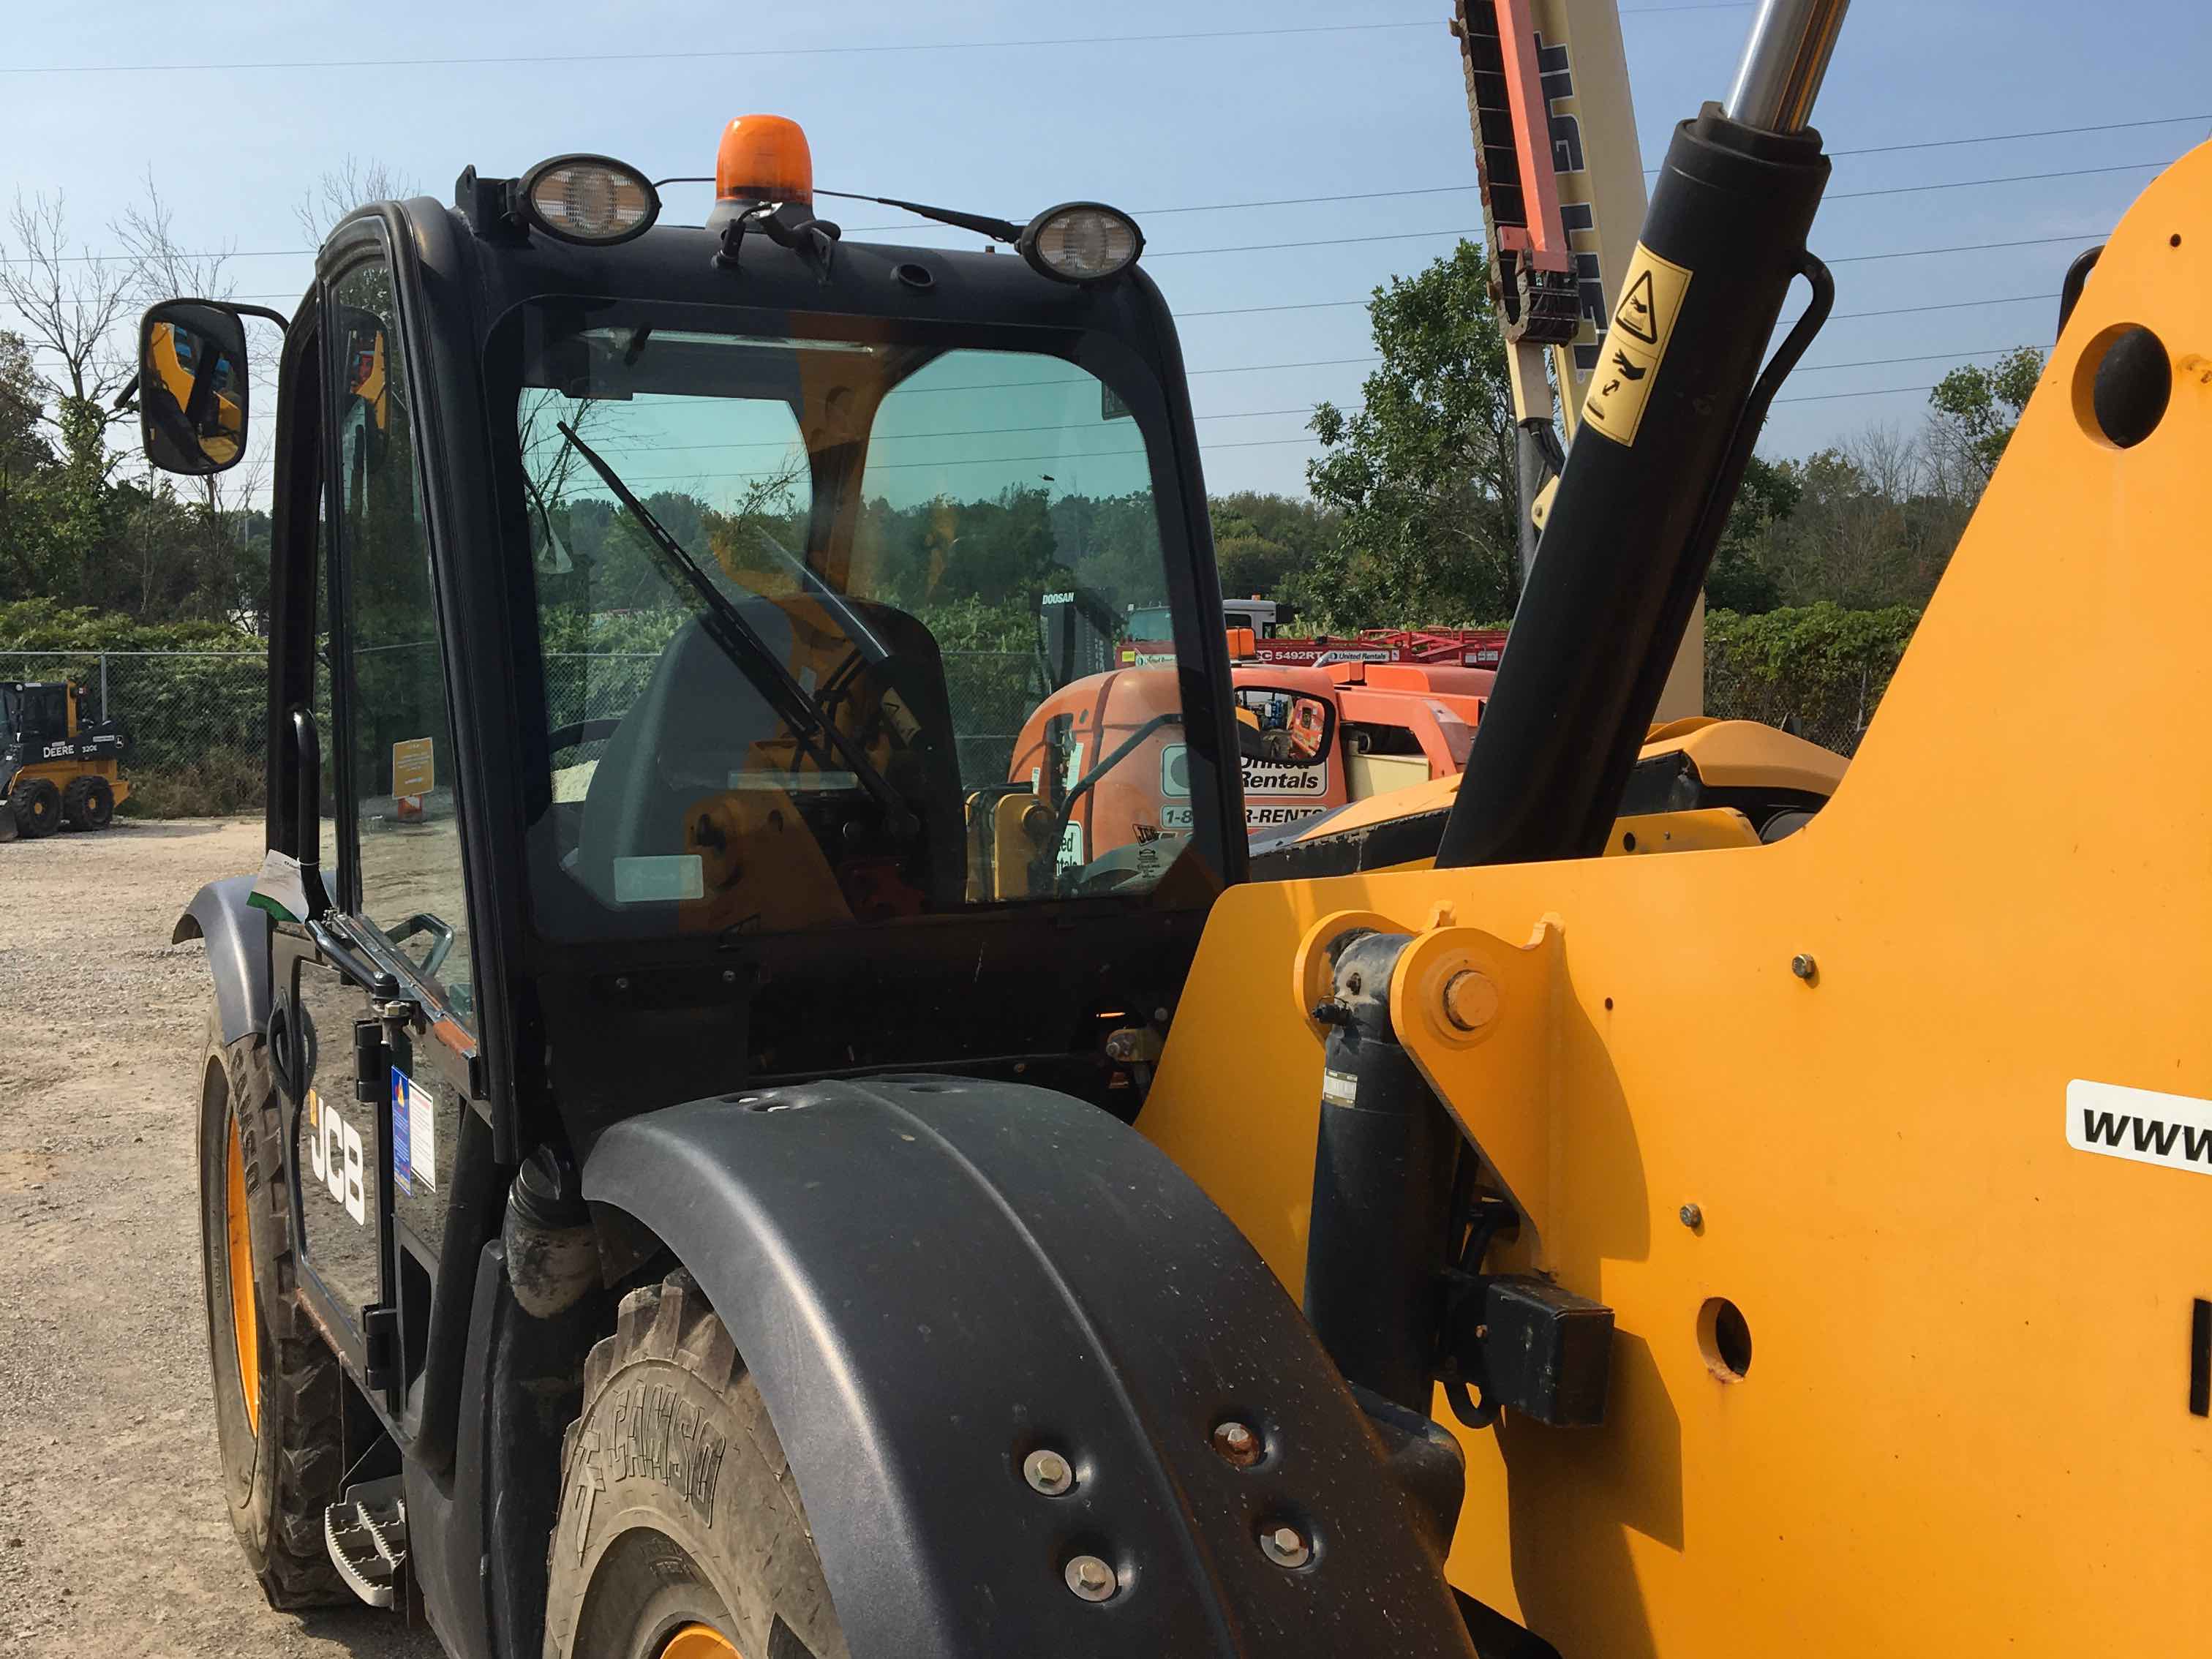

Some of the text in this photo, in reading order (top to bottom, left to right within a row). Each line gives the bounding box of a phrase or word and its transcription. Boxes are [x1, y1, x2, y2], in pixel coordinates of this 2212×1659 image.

[1042, 592, 1075, 605] DOOSAN
[1275, 651, 1323, 661] 5492RT
[43, 745, 75, 759] DEERE
[1241, 771, 1319, 789] Rentals
[311, 1088, 365, 1227] JCB
